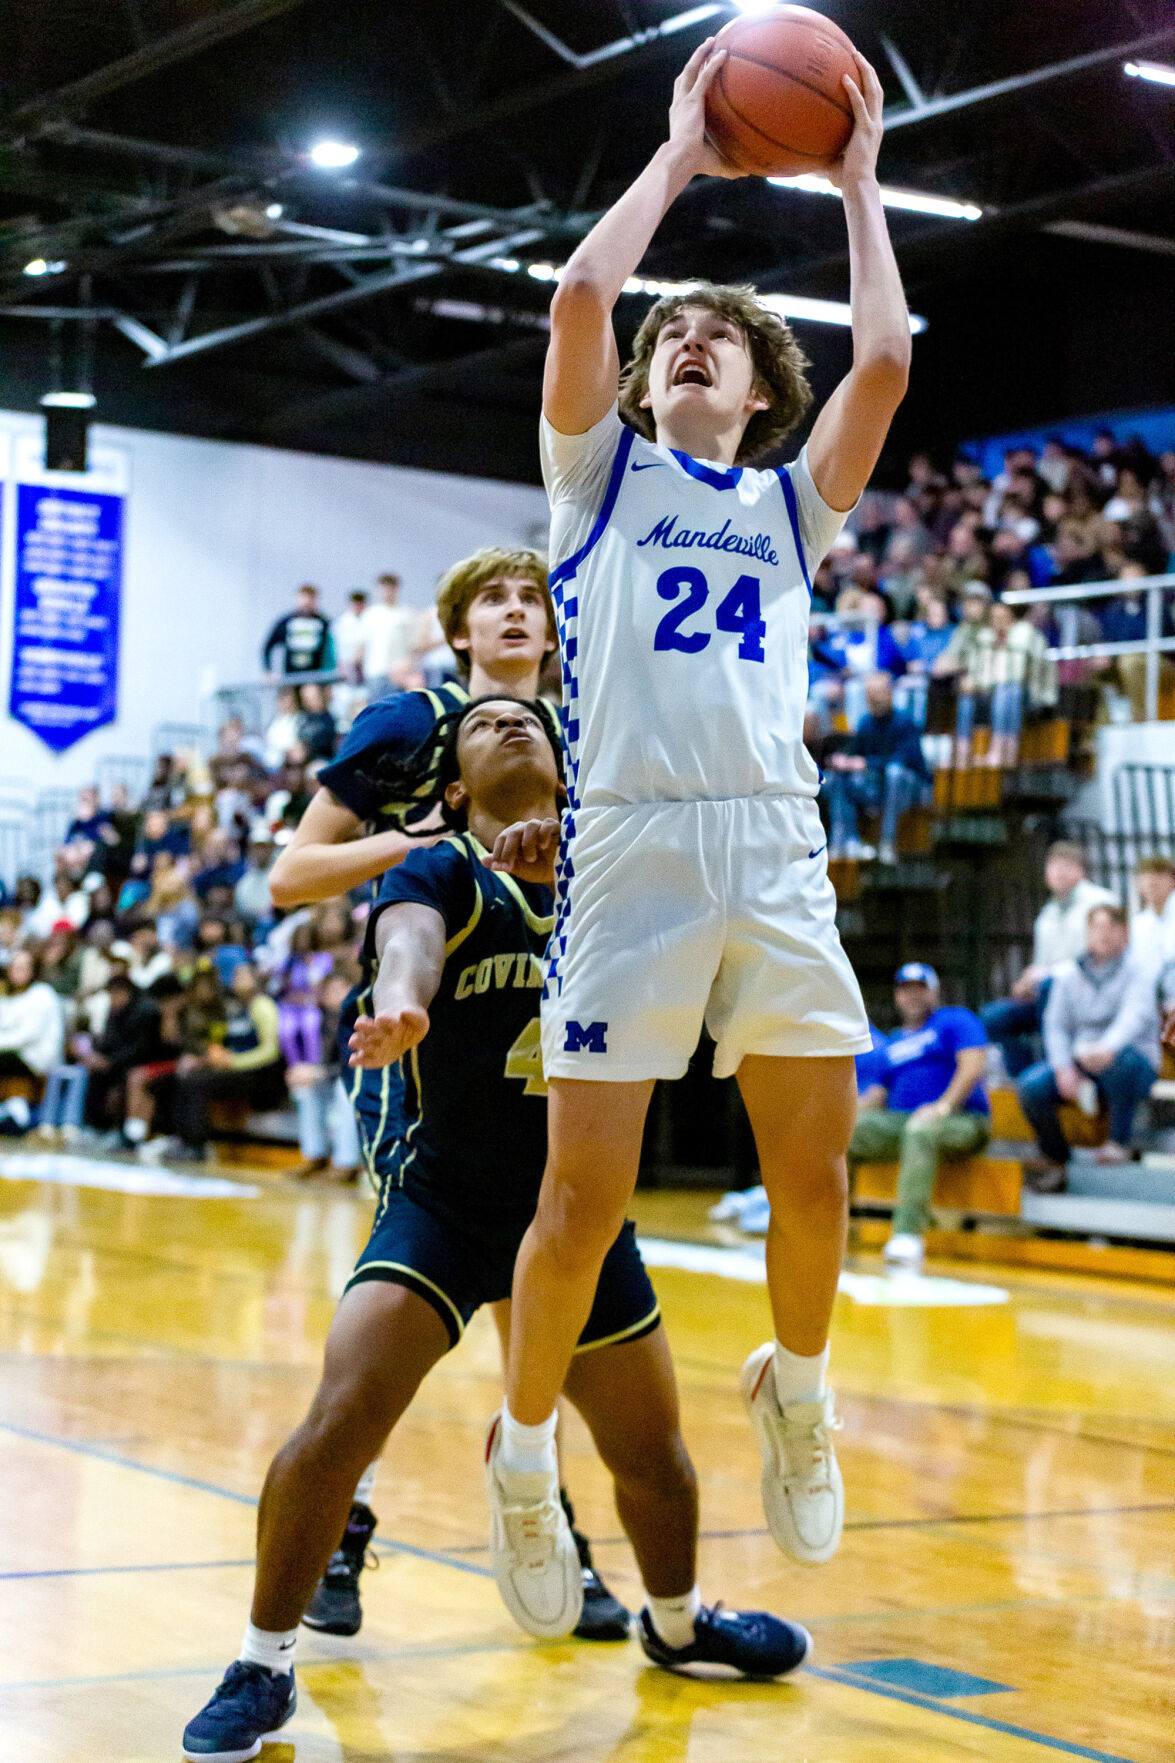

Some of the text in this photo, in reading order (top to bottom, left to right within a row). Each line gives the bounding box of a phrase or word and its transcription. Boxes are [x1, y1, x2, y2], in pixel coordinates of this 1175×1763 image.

[637, 514, 779, 566] Mandeville
[654, 566, 766, 663] 24
[563, 1021, 608, 1053] M
